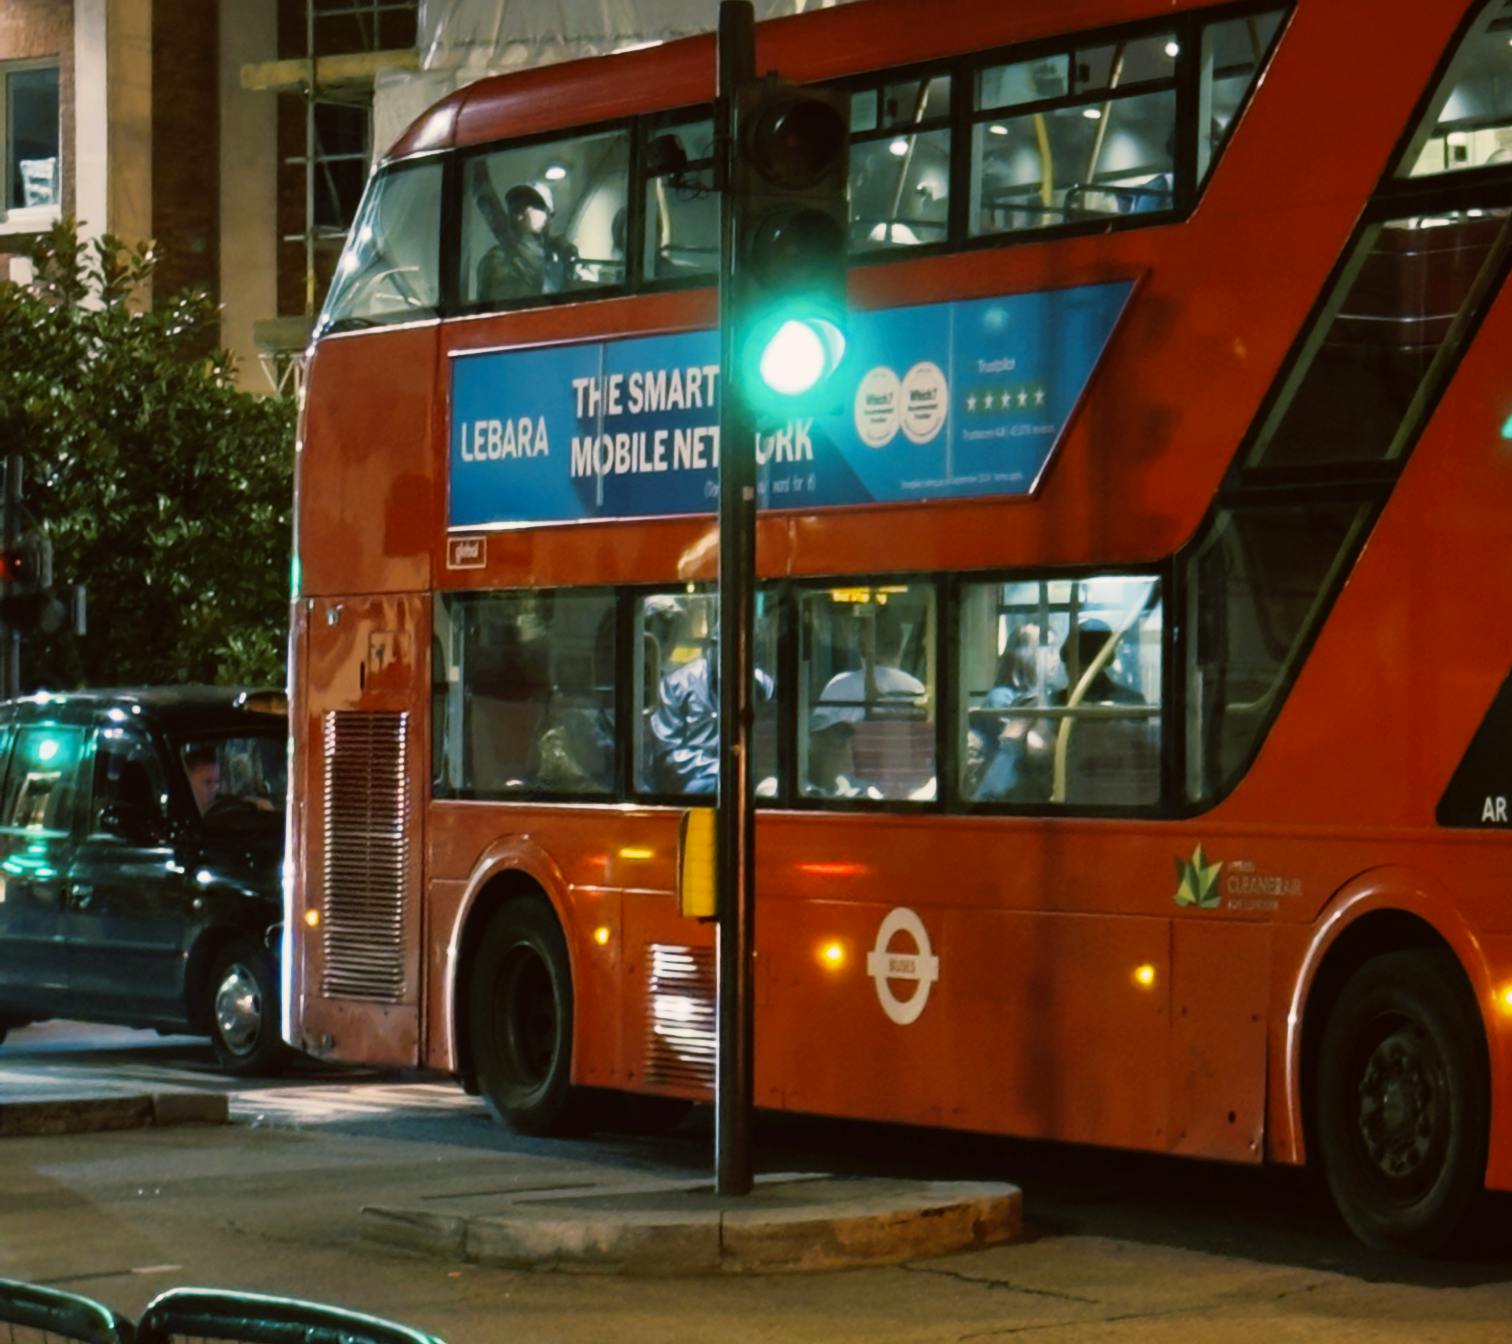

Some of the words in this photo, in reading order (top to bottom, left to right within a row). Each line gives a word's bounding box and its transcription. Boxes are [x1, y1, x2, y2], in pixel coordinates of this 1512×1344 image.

[572, 373, 623, 418] THE
[628, 364, 720, 414] SMART
[461, 415, 549, 462] LEBARA
[570, 429, 669, 478] MOBILE
[673, 418, 816, 471] NETORK
[1482, 796, 1508, 822] AR
